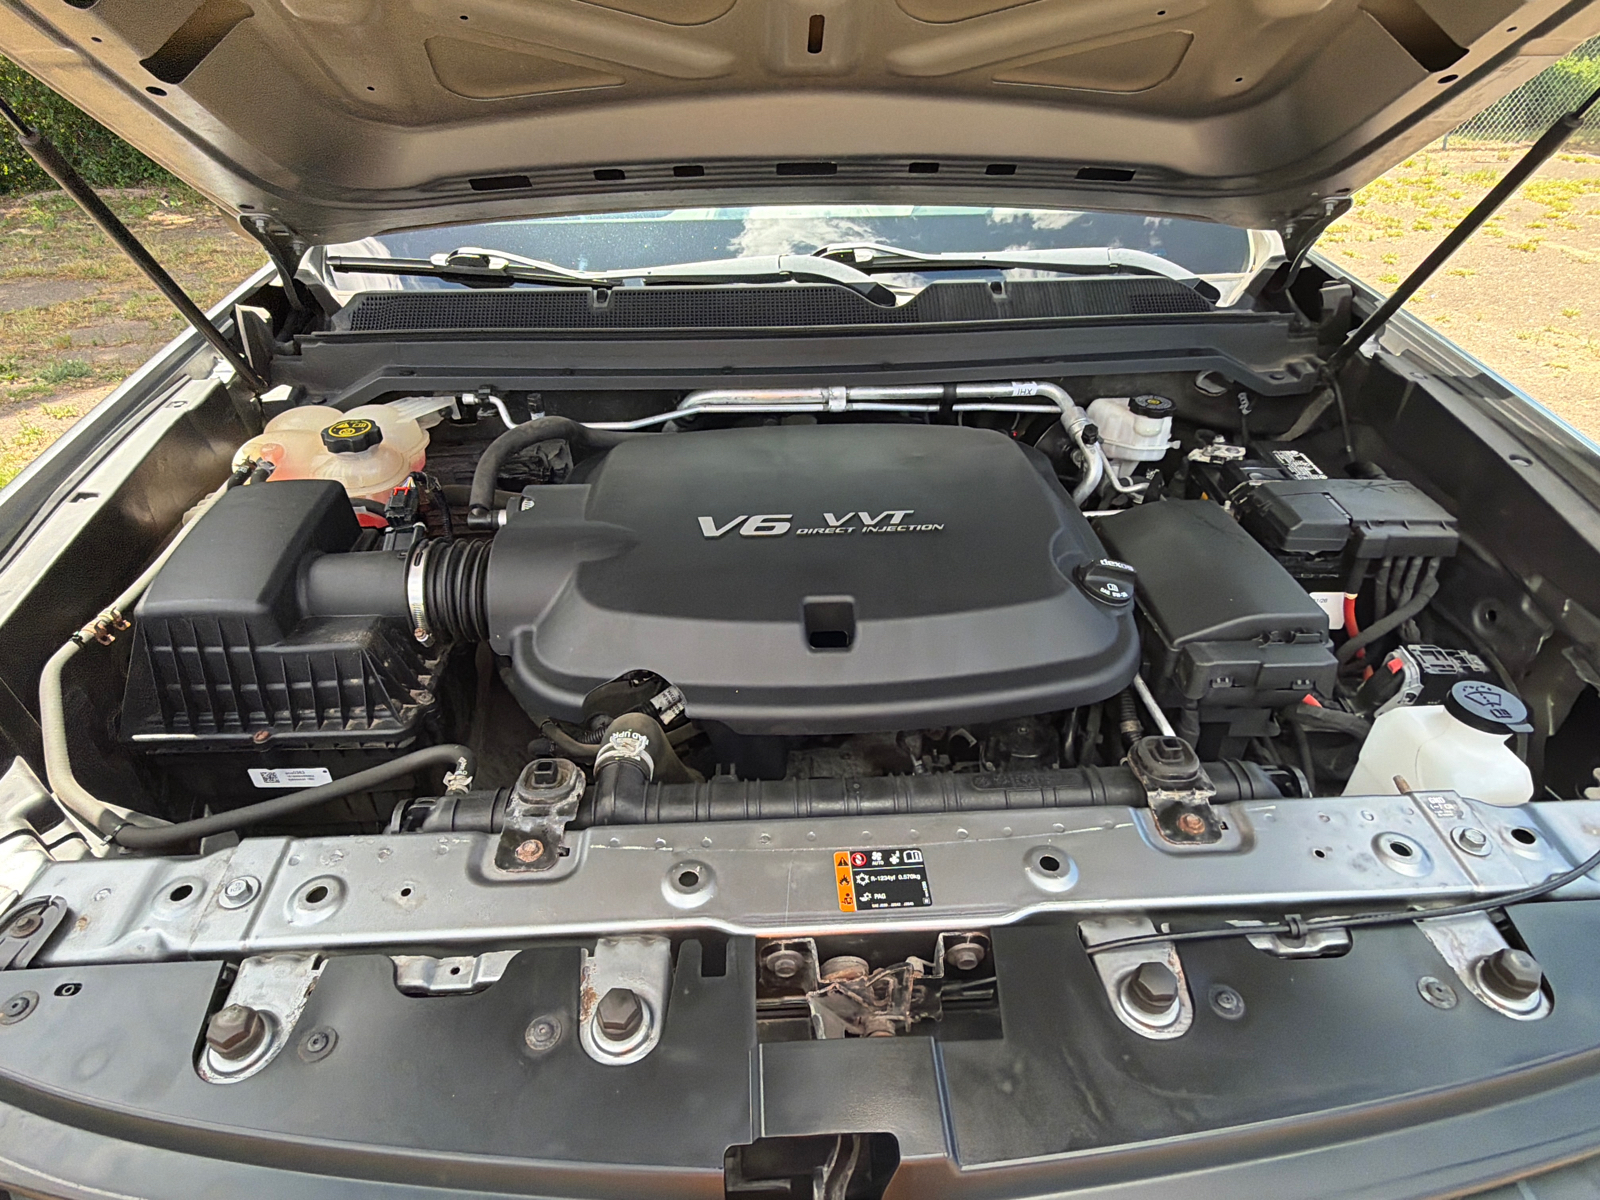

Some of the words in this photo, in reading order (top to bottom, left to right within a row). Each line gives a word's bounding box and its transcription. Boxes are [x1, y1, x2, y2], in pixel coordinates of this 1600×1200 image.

[698, 514, 793, 537] V6
[823, 510, 915, 526] VVT
[796, 526, 856, 535] DIRECT
[862, 523, 945, 533] INJECTION
